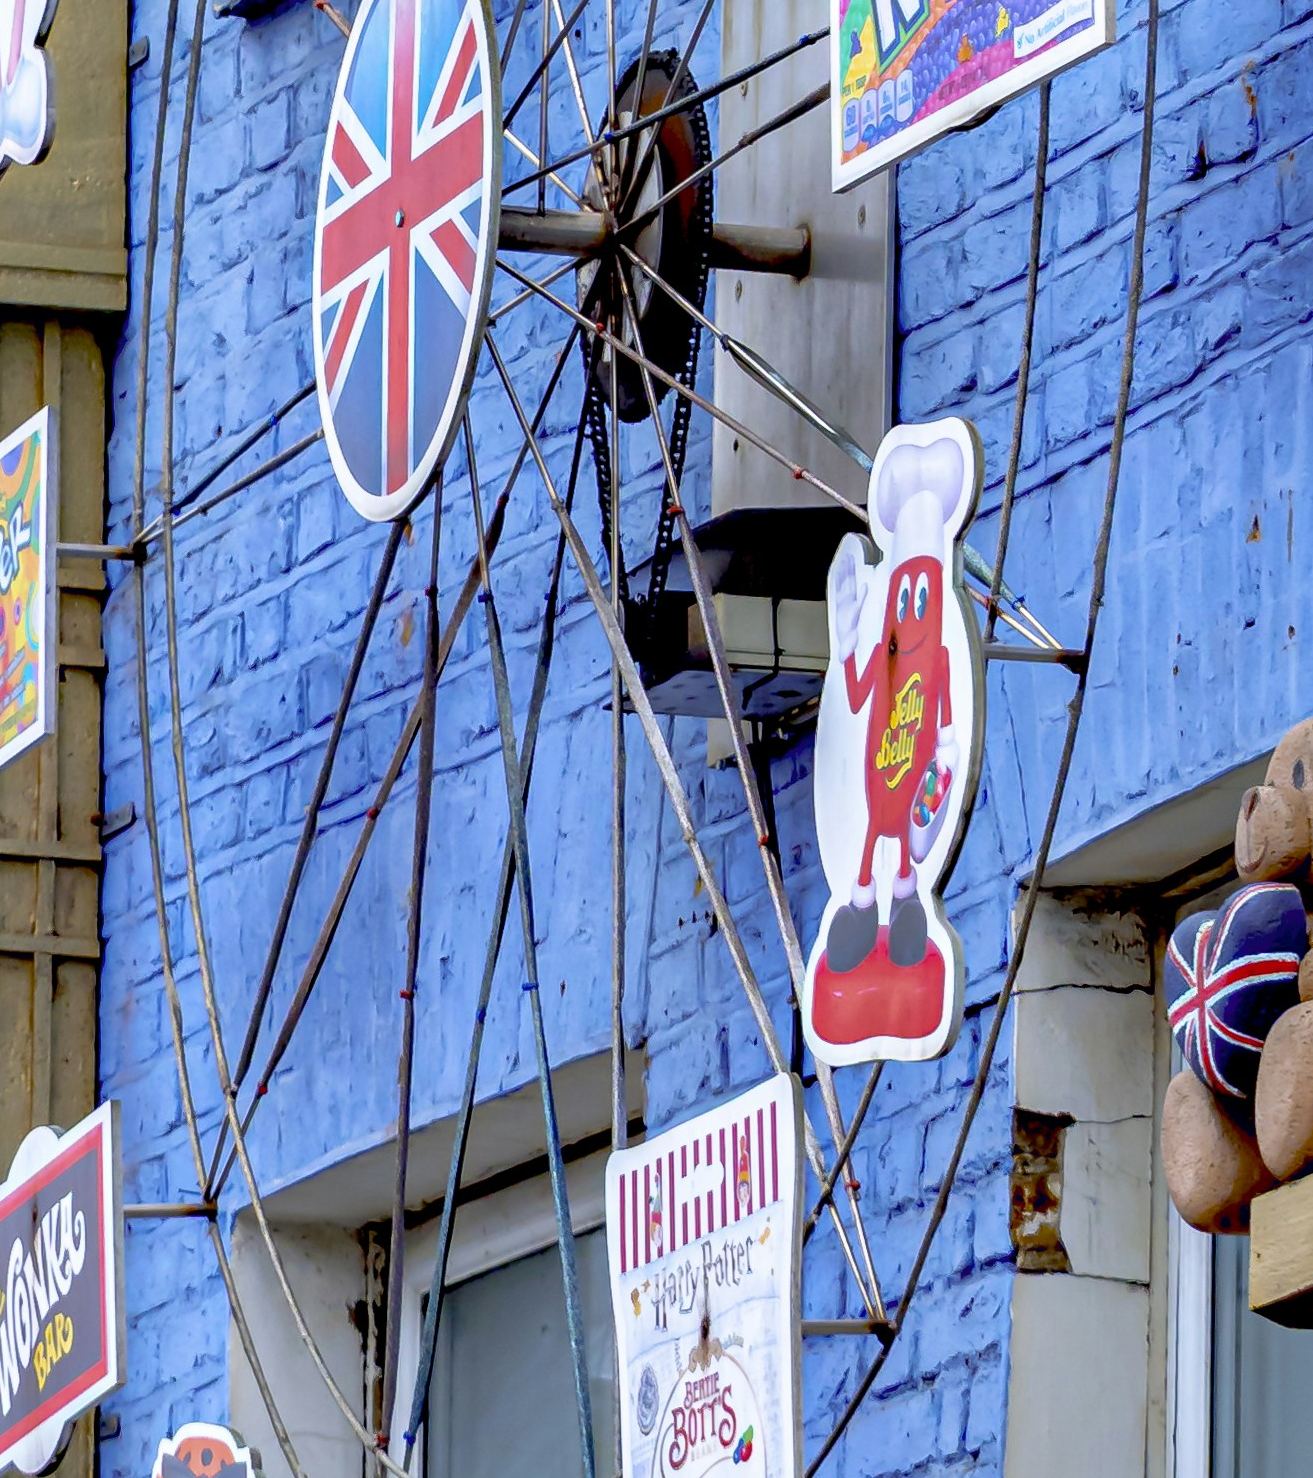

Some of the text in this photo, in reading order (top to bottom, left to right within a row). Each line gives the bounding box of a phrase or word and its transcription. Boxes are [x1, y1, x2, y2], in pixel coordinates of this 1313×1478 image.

[890, 672, 925, 733] Jelly
[875, 727, 915, 789] Belly
[651, 1236, 753, 1332] Harry Potter
[34, 1312, 74, 1392] BAR
[684, 1371, 719, 1410] BERTIE
